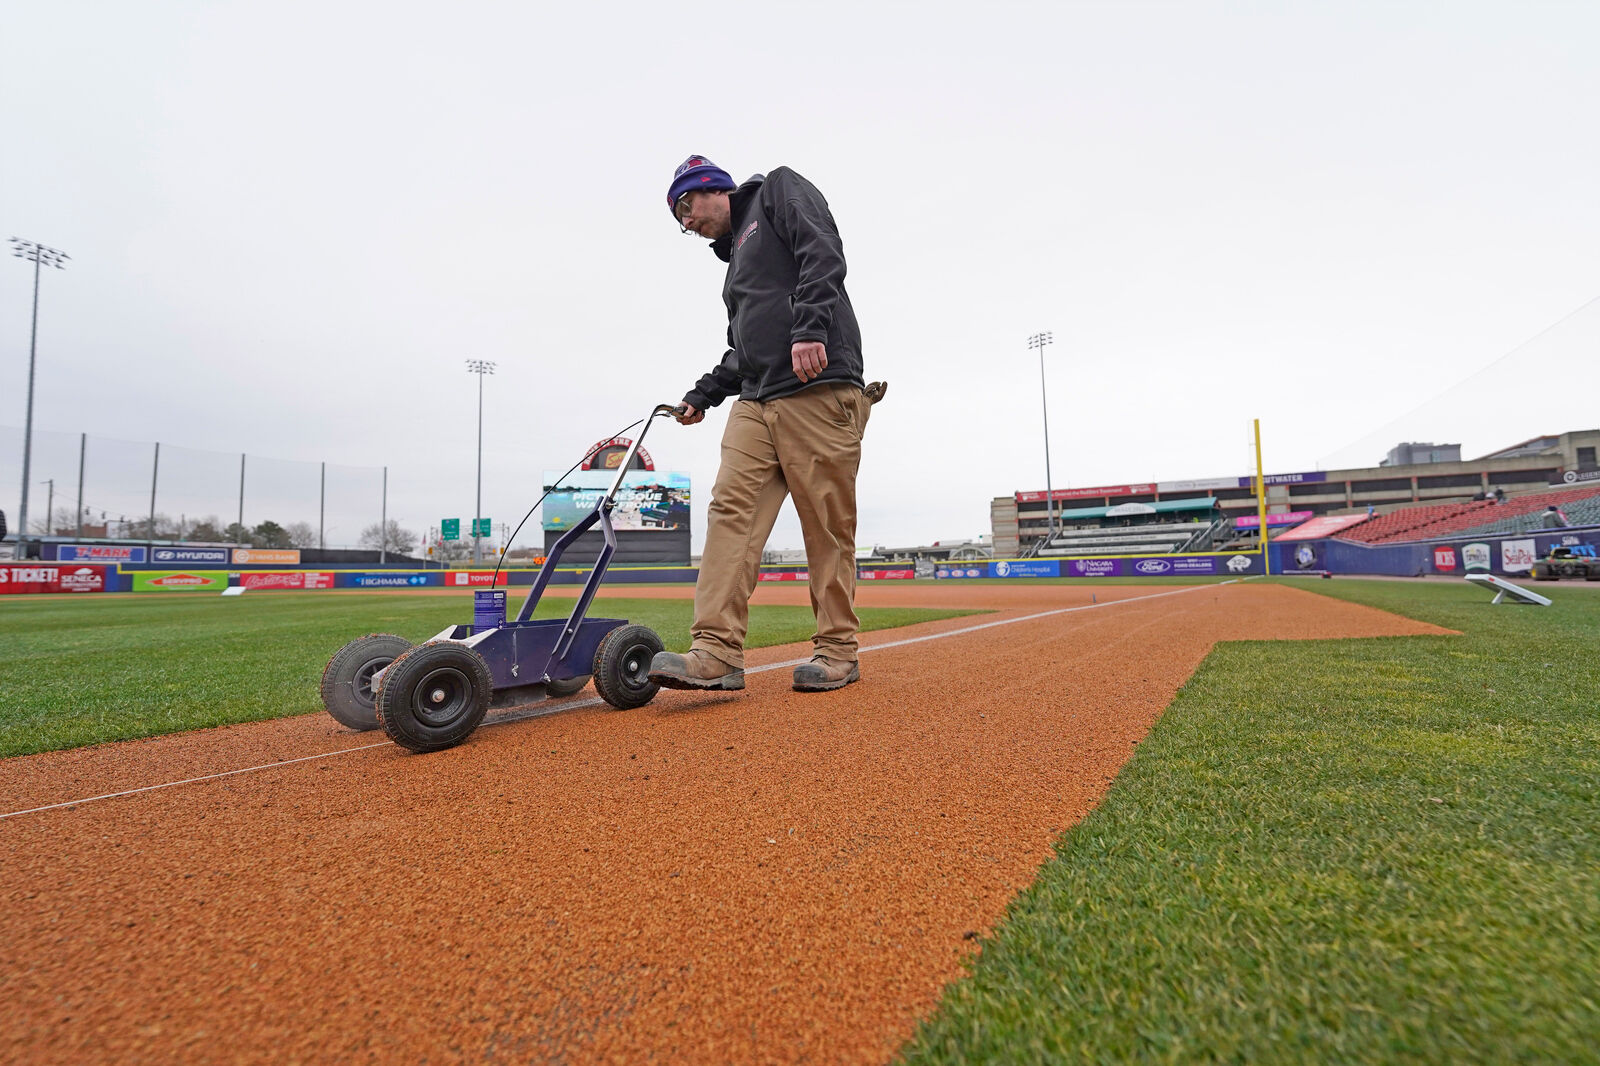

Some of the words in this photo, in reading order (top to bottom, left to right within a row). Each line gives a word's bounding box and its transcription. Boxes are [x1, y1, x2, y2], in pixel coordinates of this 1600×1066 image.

[614, 438, 630, 447] THE
[1264, 475, 1303, 483] UTWATER
[573, 492, 662, 501] PICTRESQUE
[76, 547, 131, 557] T-MARK
[177, 552, 224, 560] HYUNDAI
[1141, 561, 1164, 571] Ford
[1232, 559, 1247, 567] 325
[11, 568, 58, 583] TICKET!
[361, 578, 409, 586] HIGHMARK
